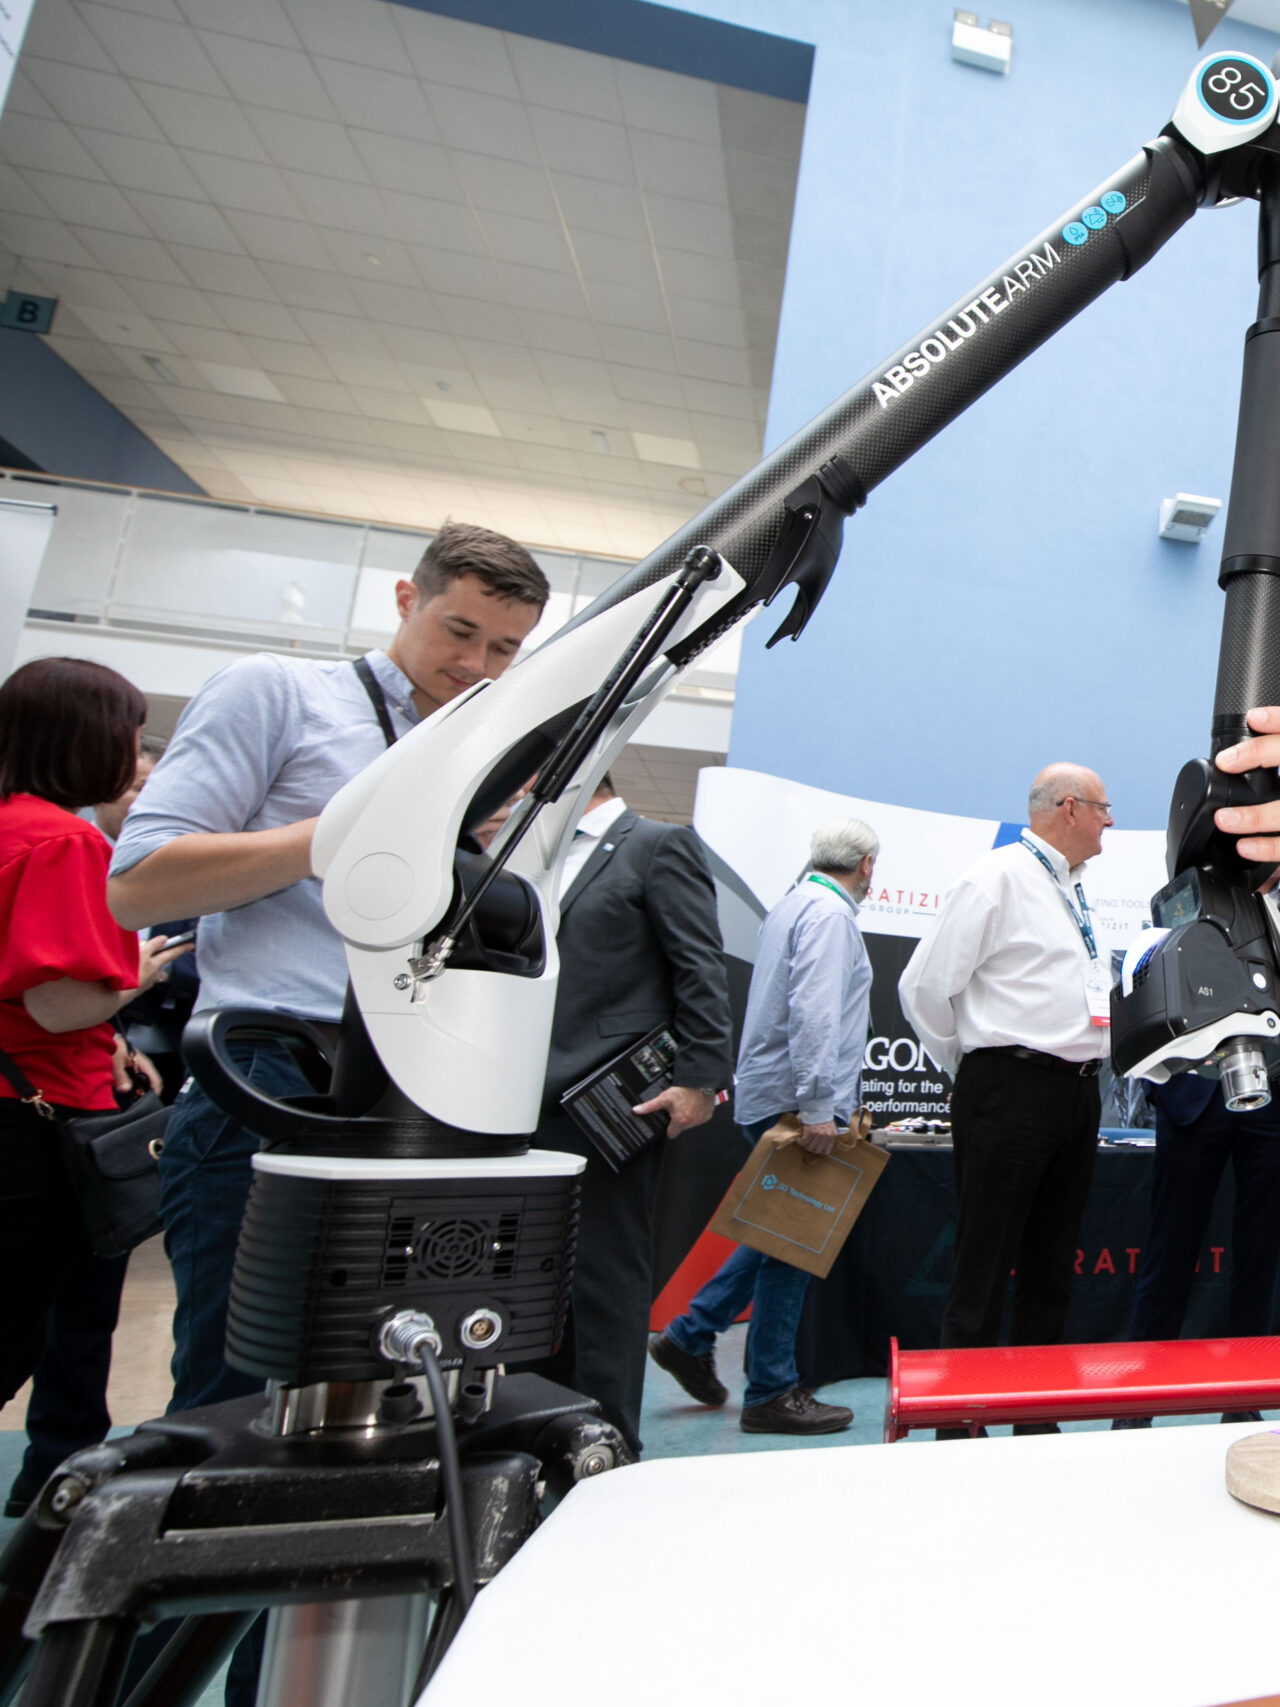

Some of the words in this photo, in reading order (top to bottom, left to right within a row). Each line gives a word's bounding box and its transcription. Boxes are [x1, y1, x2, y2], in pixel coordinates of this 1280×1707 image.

[1208, 67, 1265, 110] 85
[18, 300, 39, 324] B
[869, 904, 909, 914] GROUP
[1198, 986, 1213, 997] AS1
[861, 1037, 943, 1073] GON
[898, 1079, 917, 1093] for
[920, 1080, 943, 1094] the
[866, 1098, 951, 1113] performance
